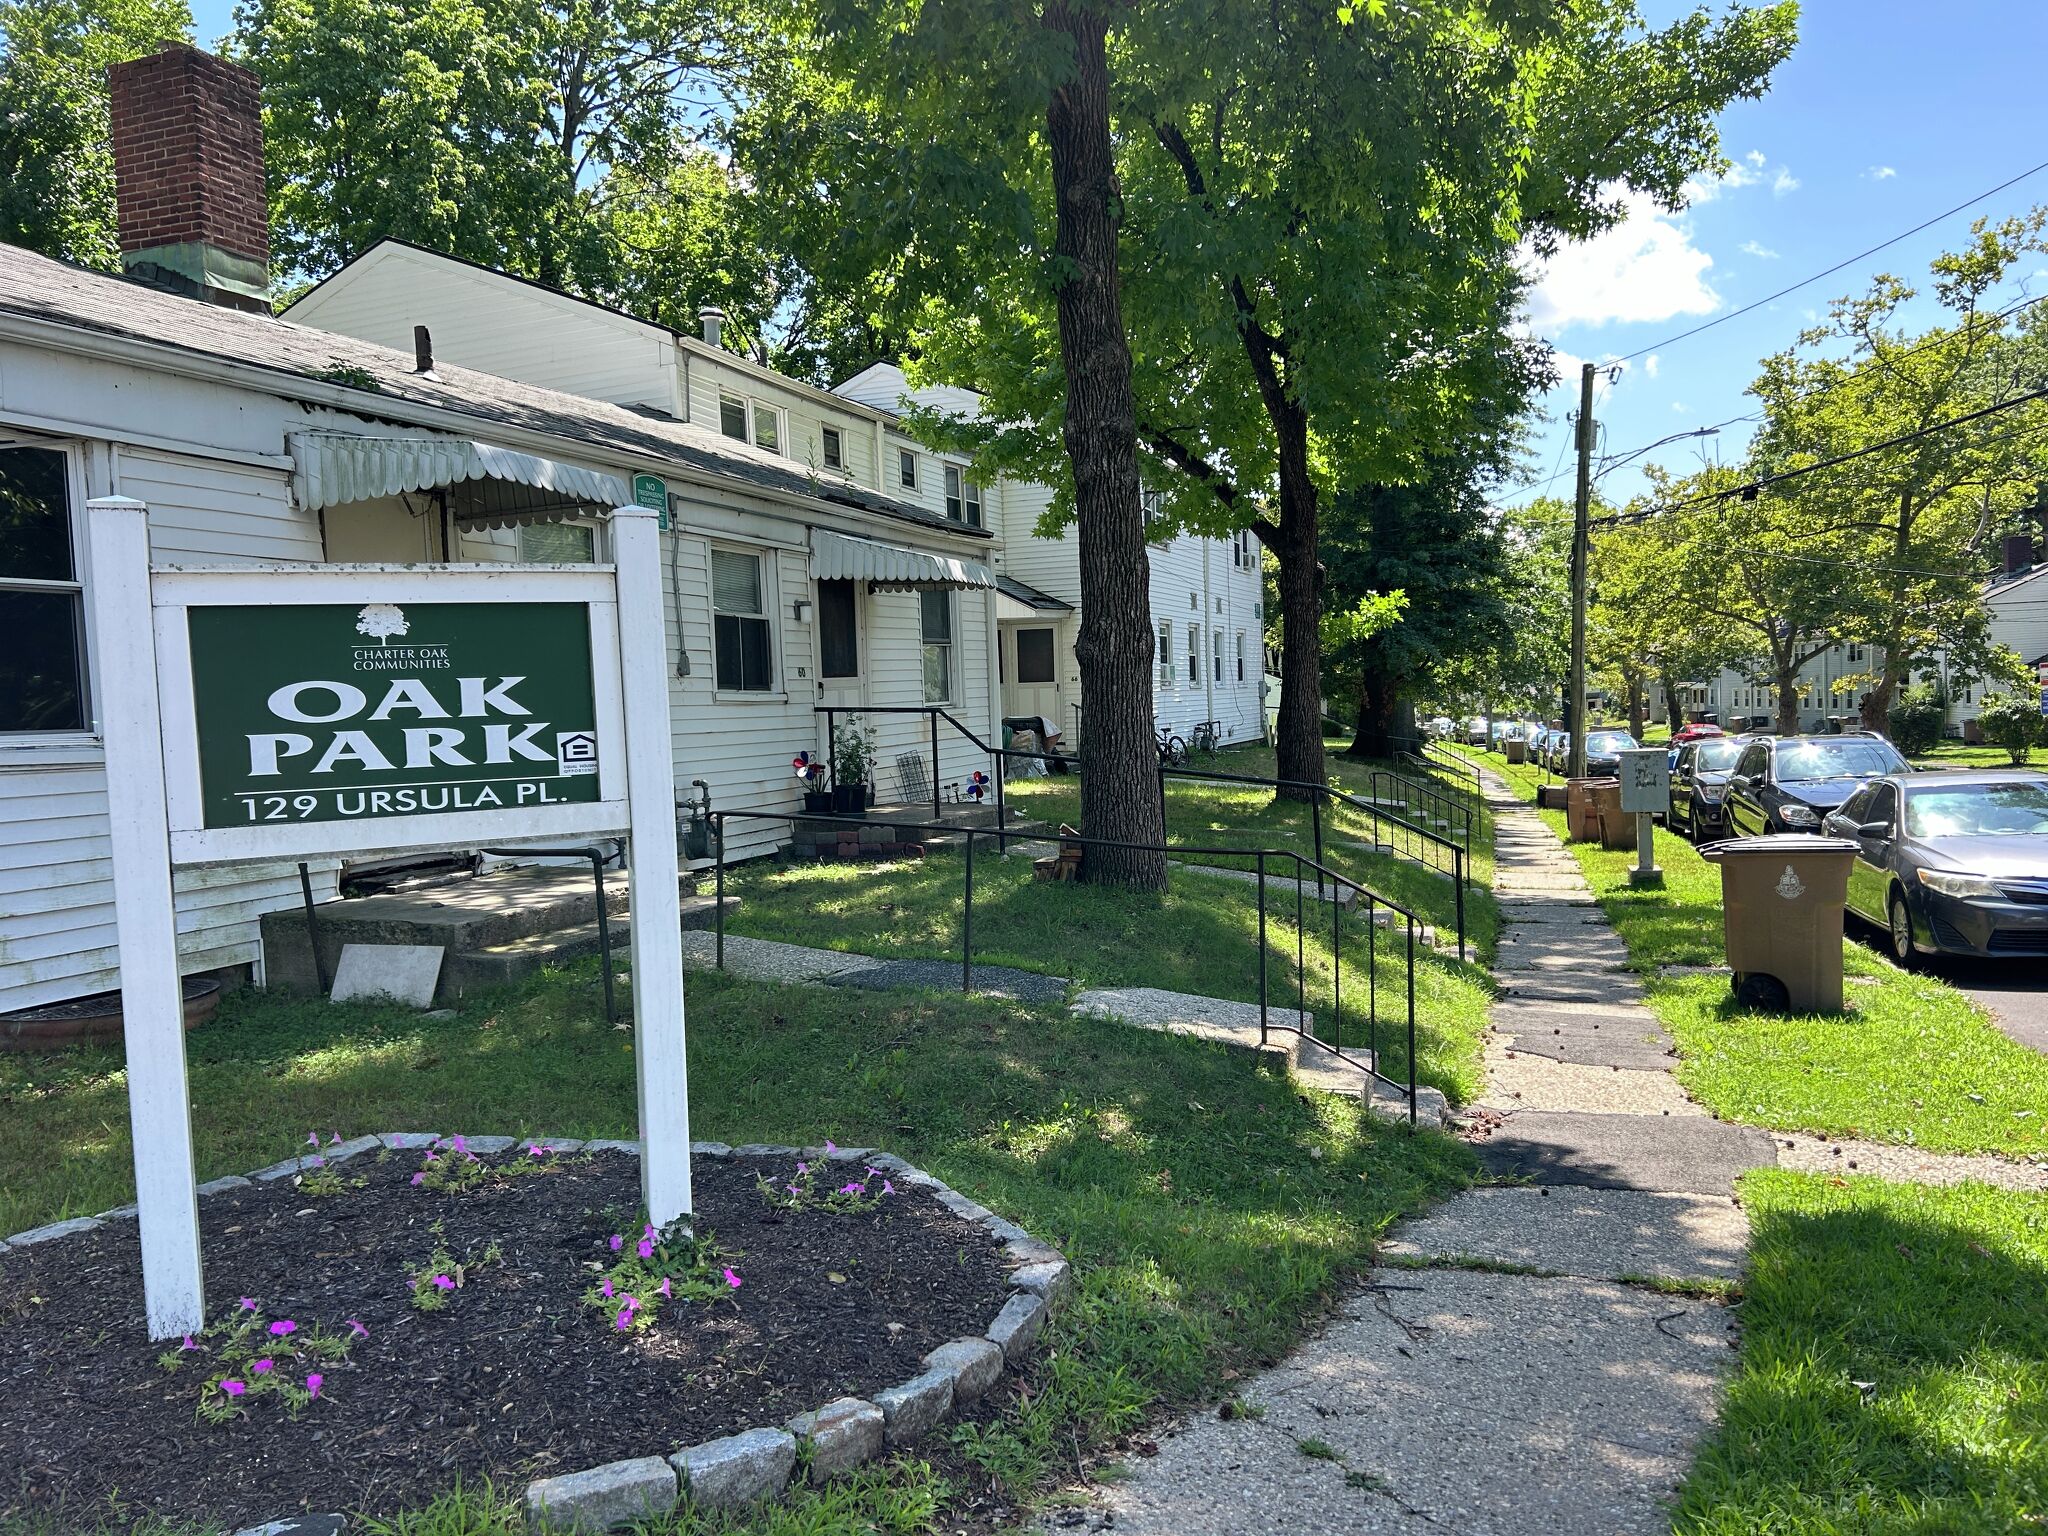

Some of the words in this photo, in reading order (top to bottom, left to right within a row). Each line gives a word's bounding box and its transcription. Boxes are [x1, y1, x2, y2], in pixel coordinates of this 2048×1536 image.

[646, 482, 655, 491] NO
[637, 489, 664, 499] TRESPASSING
[640, 496, 662, 505] SOLICITING
[353, 649, 415, 660] CHARTER
[420, 648, 448, 659] OAK
[353, 659, 451, 671] COMMUNITIES
[267, 676, 533, 724] OAK
[244, 722, 558, 777] PARK
[241, 796, 318, 821] 129
[336, 785, 503, 815] URSULA
[516, 782, 568, 804] PL.
